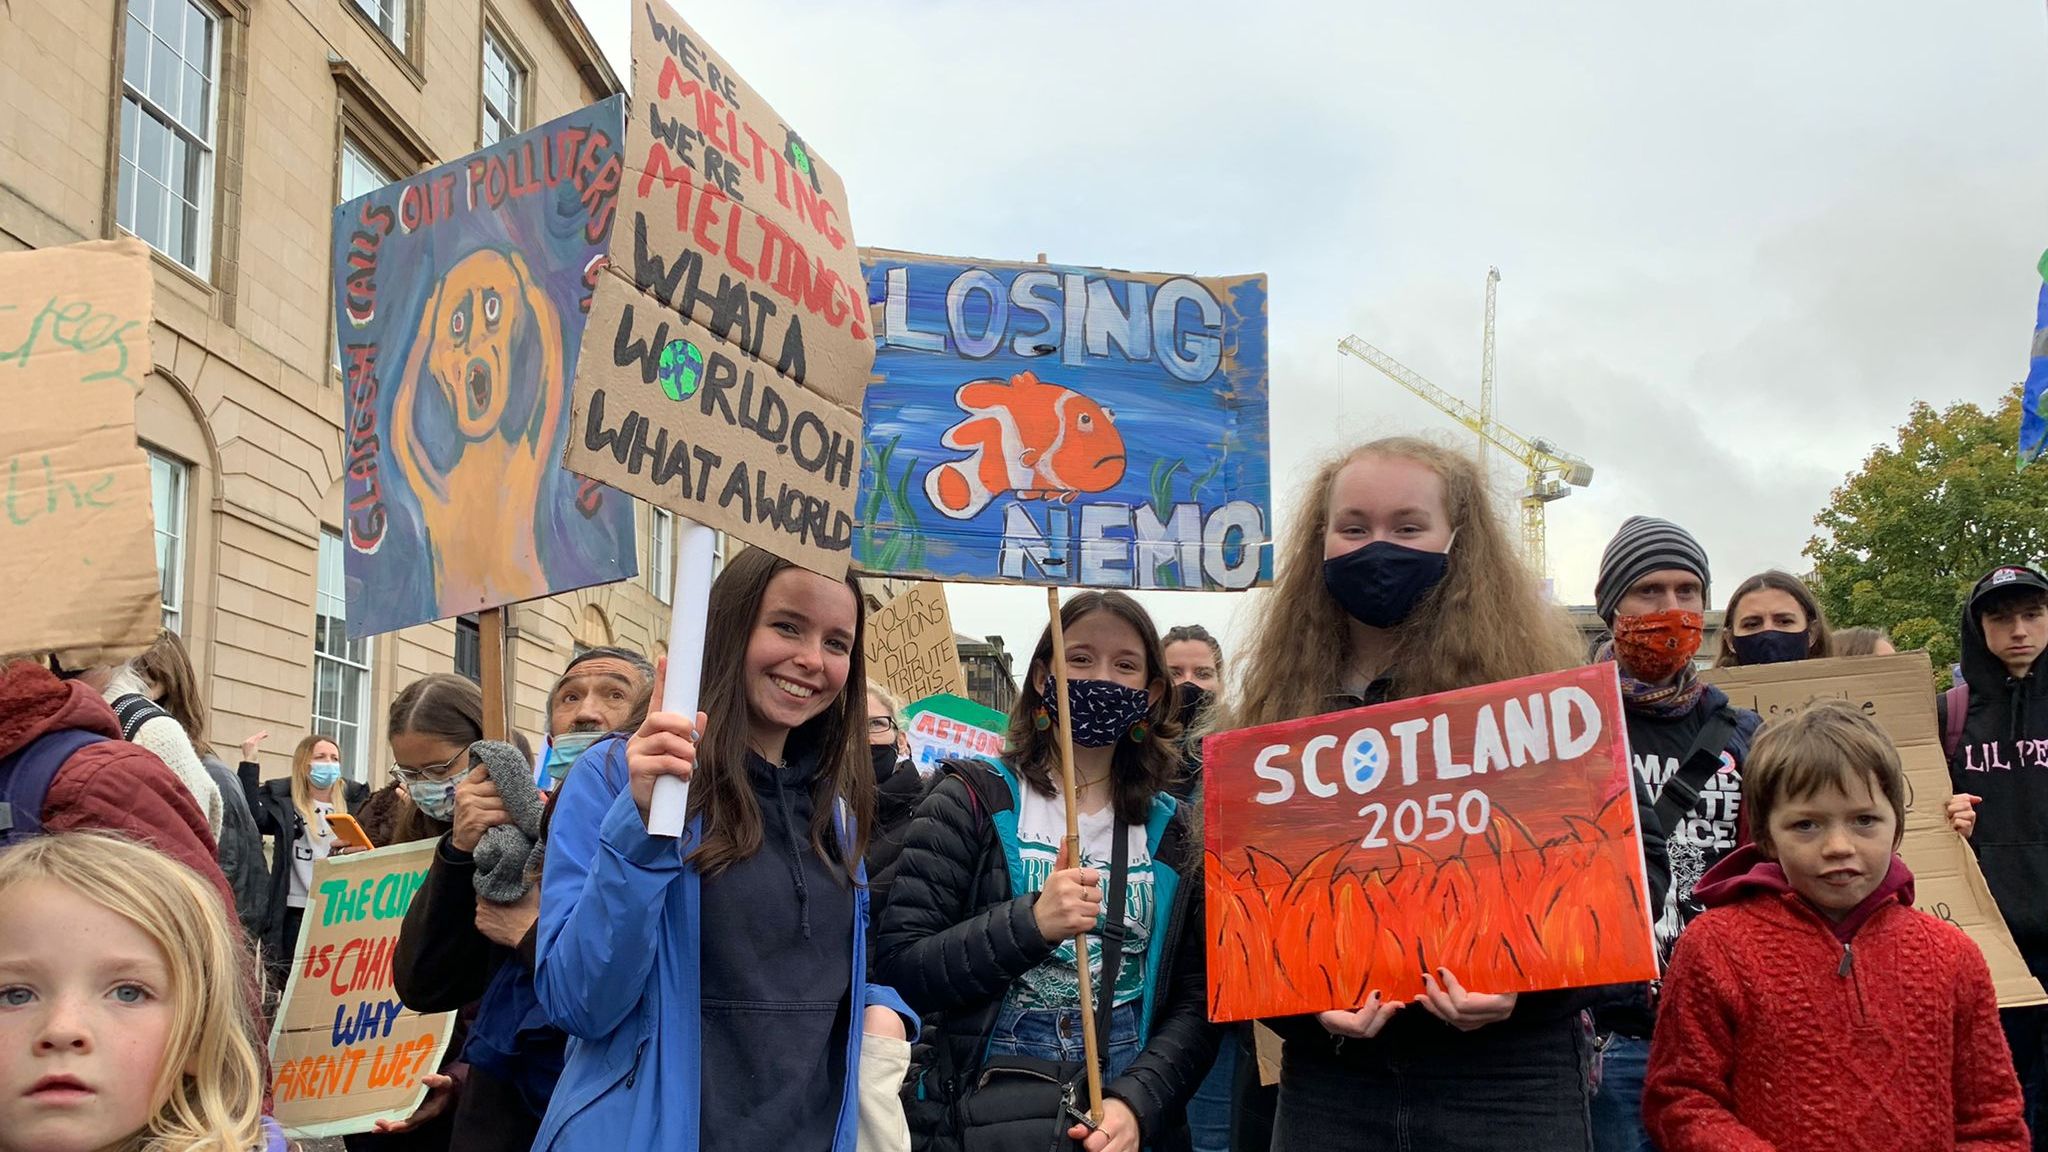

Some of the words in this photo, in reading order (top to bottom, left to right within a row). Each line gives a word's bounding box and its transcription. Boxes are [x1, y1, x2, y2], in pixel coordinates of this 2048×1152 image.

[646, 3, 740, 110] WE'RE
[650, 102, 744, 201] WE'RE
[658, 56, 846, 250] MELTING
[345, 202, 396, 329] CALLS
[399, 173, 456, 234] OUT
[465, 123, 625, 245] POLLUTERS
[638, 142, 866, 340] MELTING!
[0, 297, 140, 388] rees
[634, 211, 777, 363] WHAT
[776, 314, 807, 388] A
[883, 265, 1224, 383] LOSING
[585, 389, 722, 503] WHAT
[718, 461, 752, 524] A
[756, 470, 851, 551] WORLD
[998, 499, 1265, 589] NEMO
[868, 589, 923, 639] YOUR
[884, 641, 919, 678] DID
[902, 669, 944, 704] THIS
[916, 714, 1006, 756] ACTION
[1254, 686, 1602, 804] SCOTLAND
[1965, 741, 2011, 772] LIL
[2016, 739, 2048, 768] PE
[1357, 788, 1491, 849] 2050
[319, 878, 375, 927] THE
[372, 868, 430, 920] CLIM
[304, 943, 335, 978] IS
[330, 936, 399, 997] CHAN
[331, 998, 405, 1048] WHY
[368, 1033, 436, 1089] WE?
